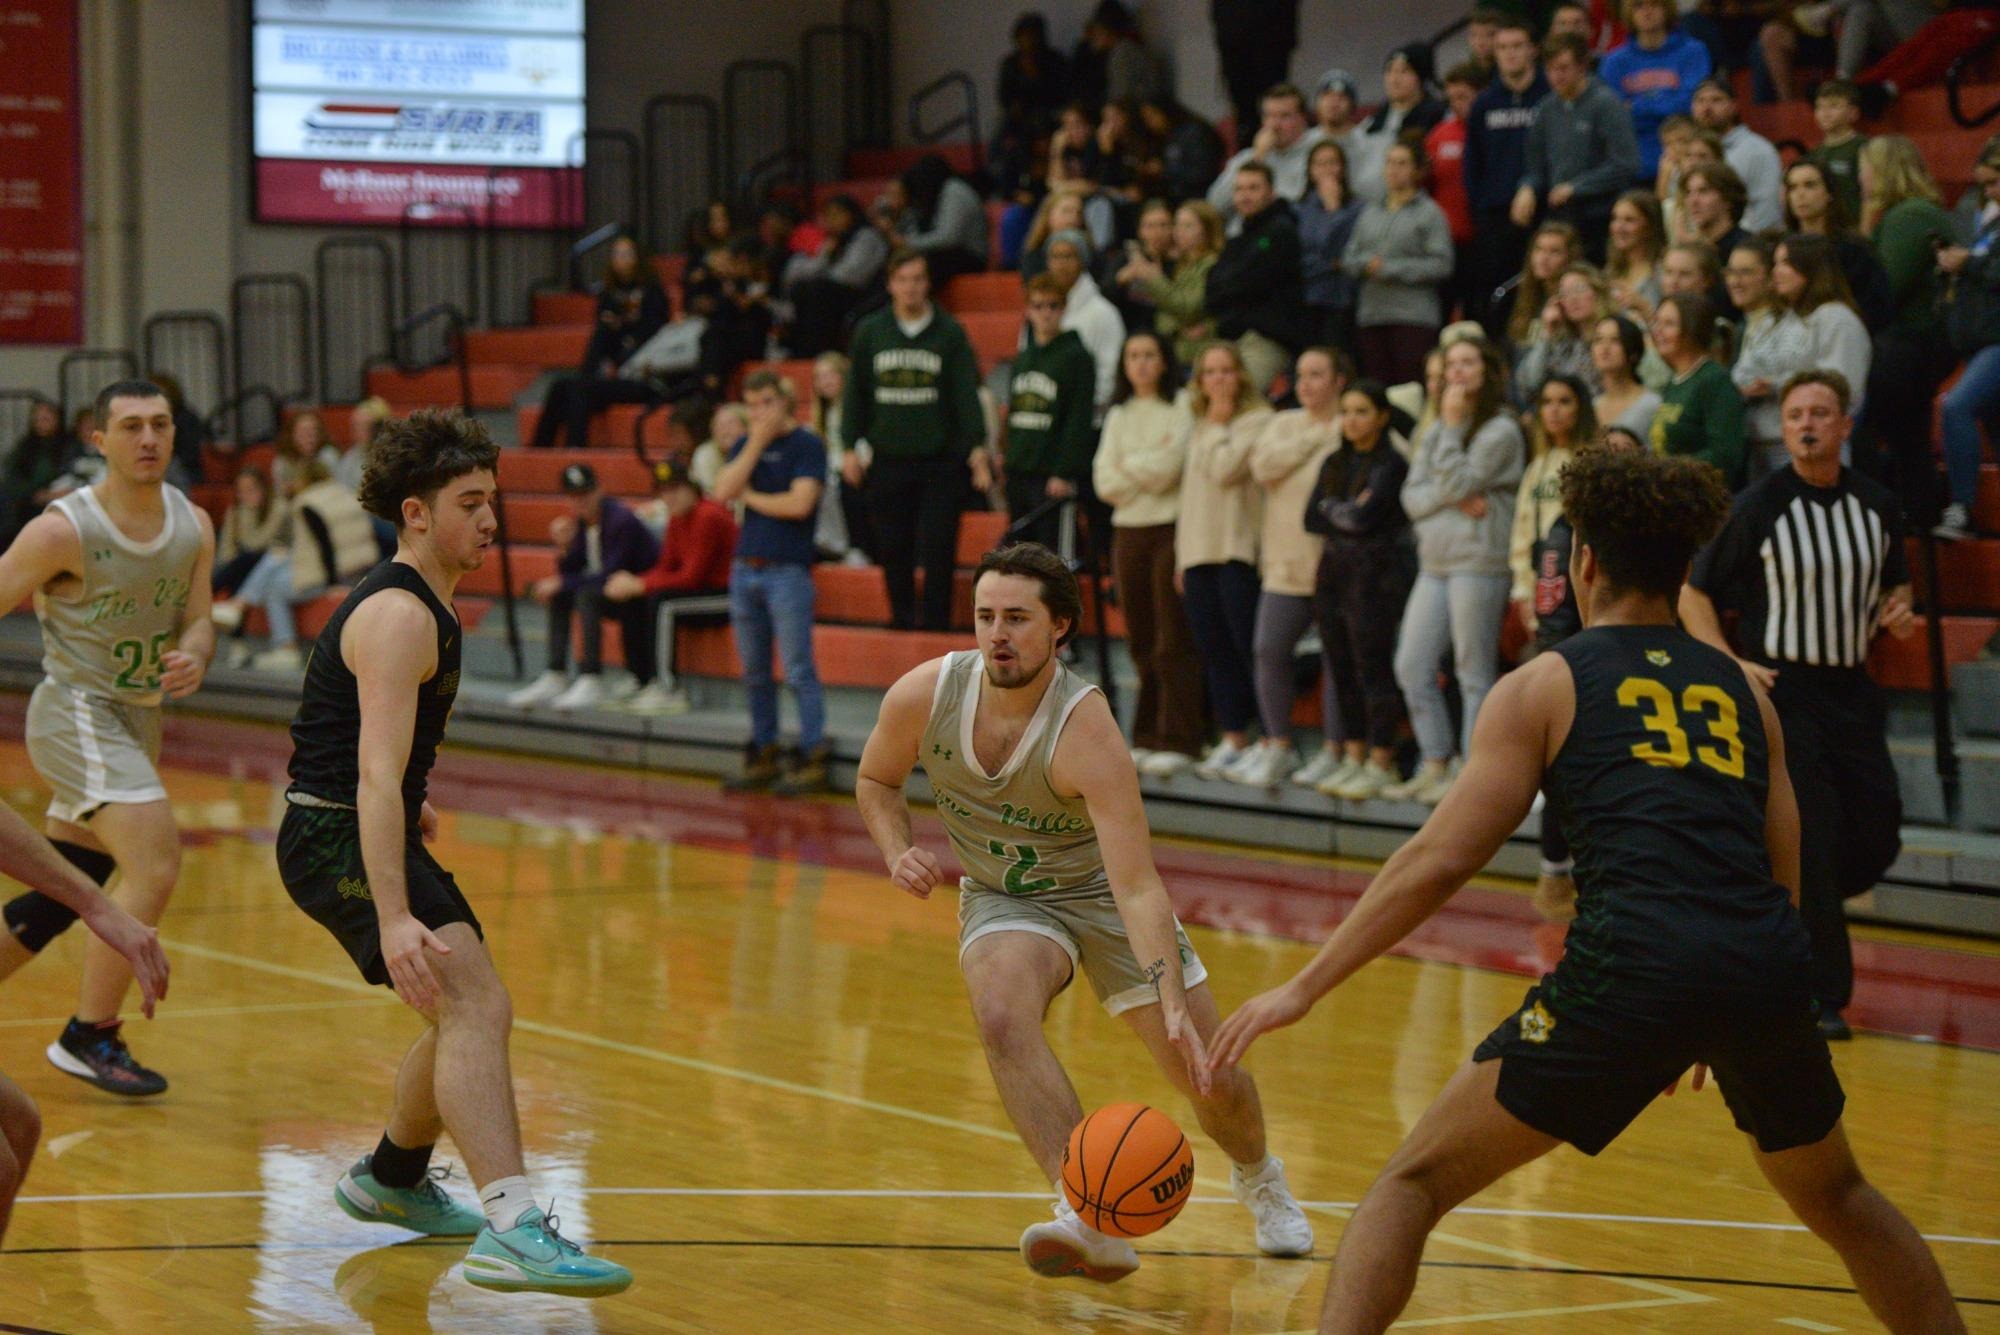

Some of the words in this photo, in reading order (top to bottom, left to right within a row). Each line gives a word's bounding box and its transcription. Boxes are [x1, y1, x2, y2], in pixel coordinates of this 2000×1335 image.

[1616, 676, 1745, 779] 33
[1000, 802, 1085, 833] Ville
[986, 840, 1059, 895] 2
